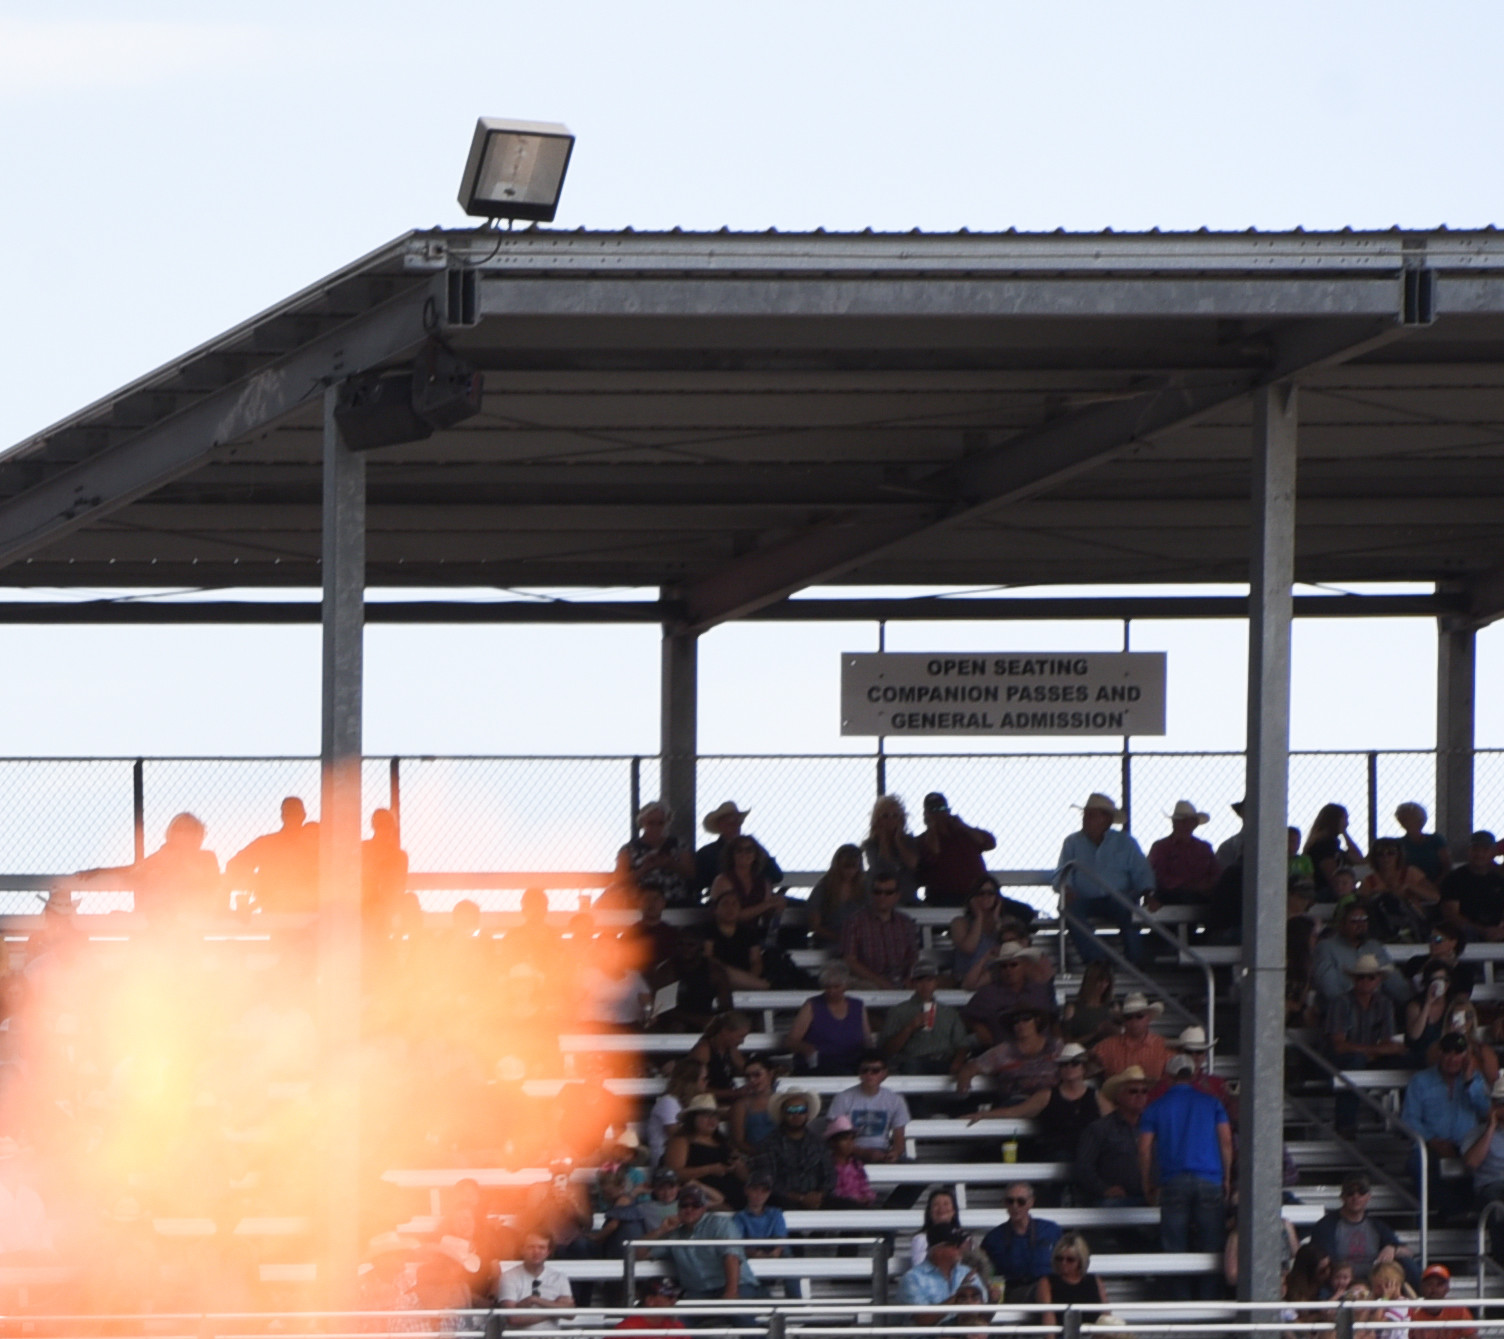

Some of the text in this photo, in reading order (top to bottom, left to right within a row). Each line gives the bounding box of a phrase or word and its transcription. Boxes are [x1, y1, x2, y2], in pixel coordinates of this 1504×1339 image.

[926, 658, 1088, 676] OPEN SEATING
[866, 684, 1142, 703] COMPANION PASSES AND
[890, 711, 1124, 730] GENERAL ADMISSION
